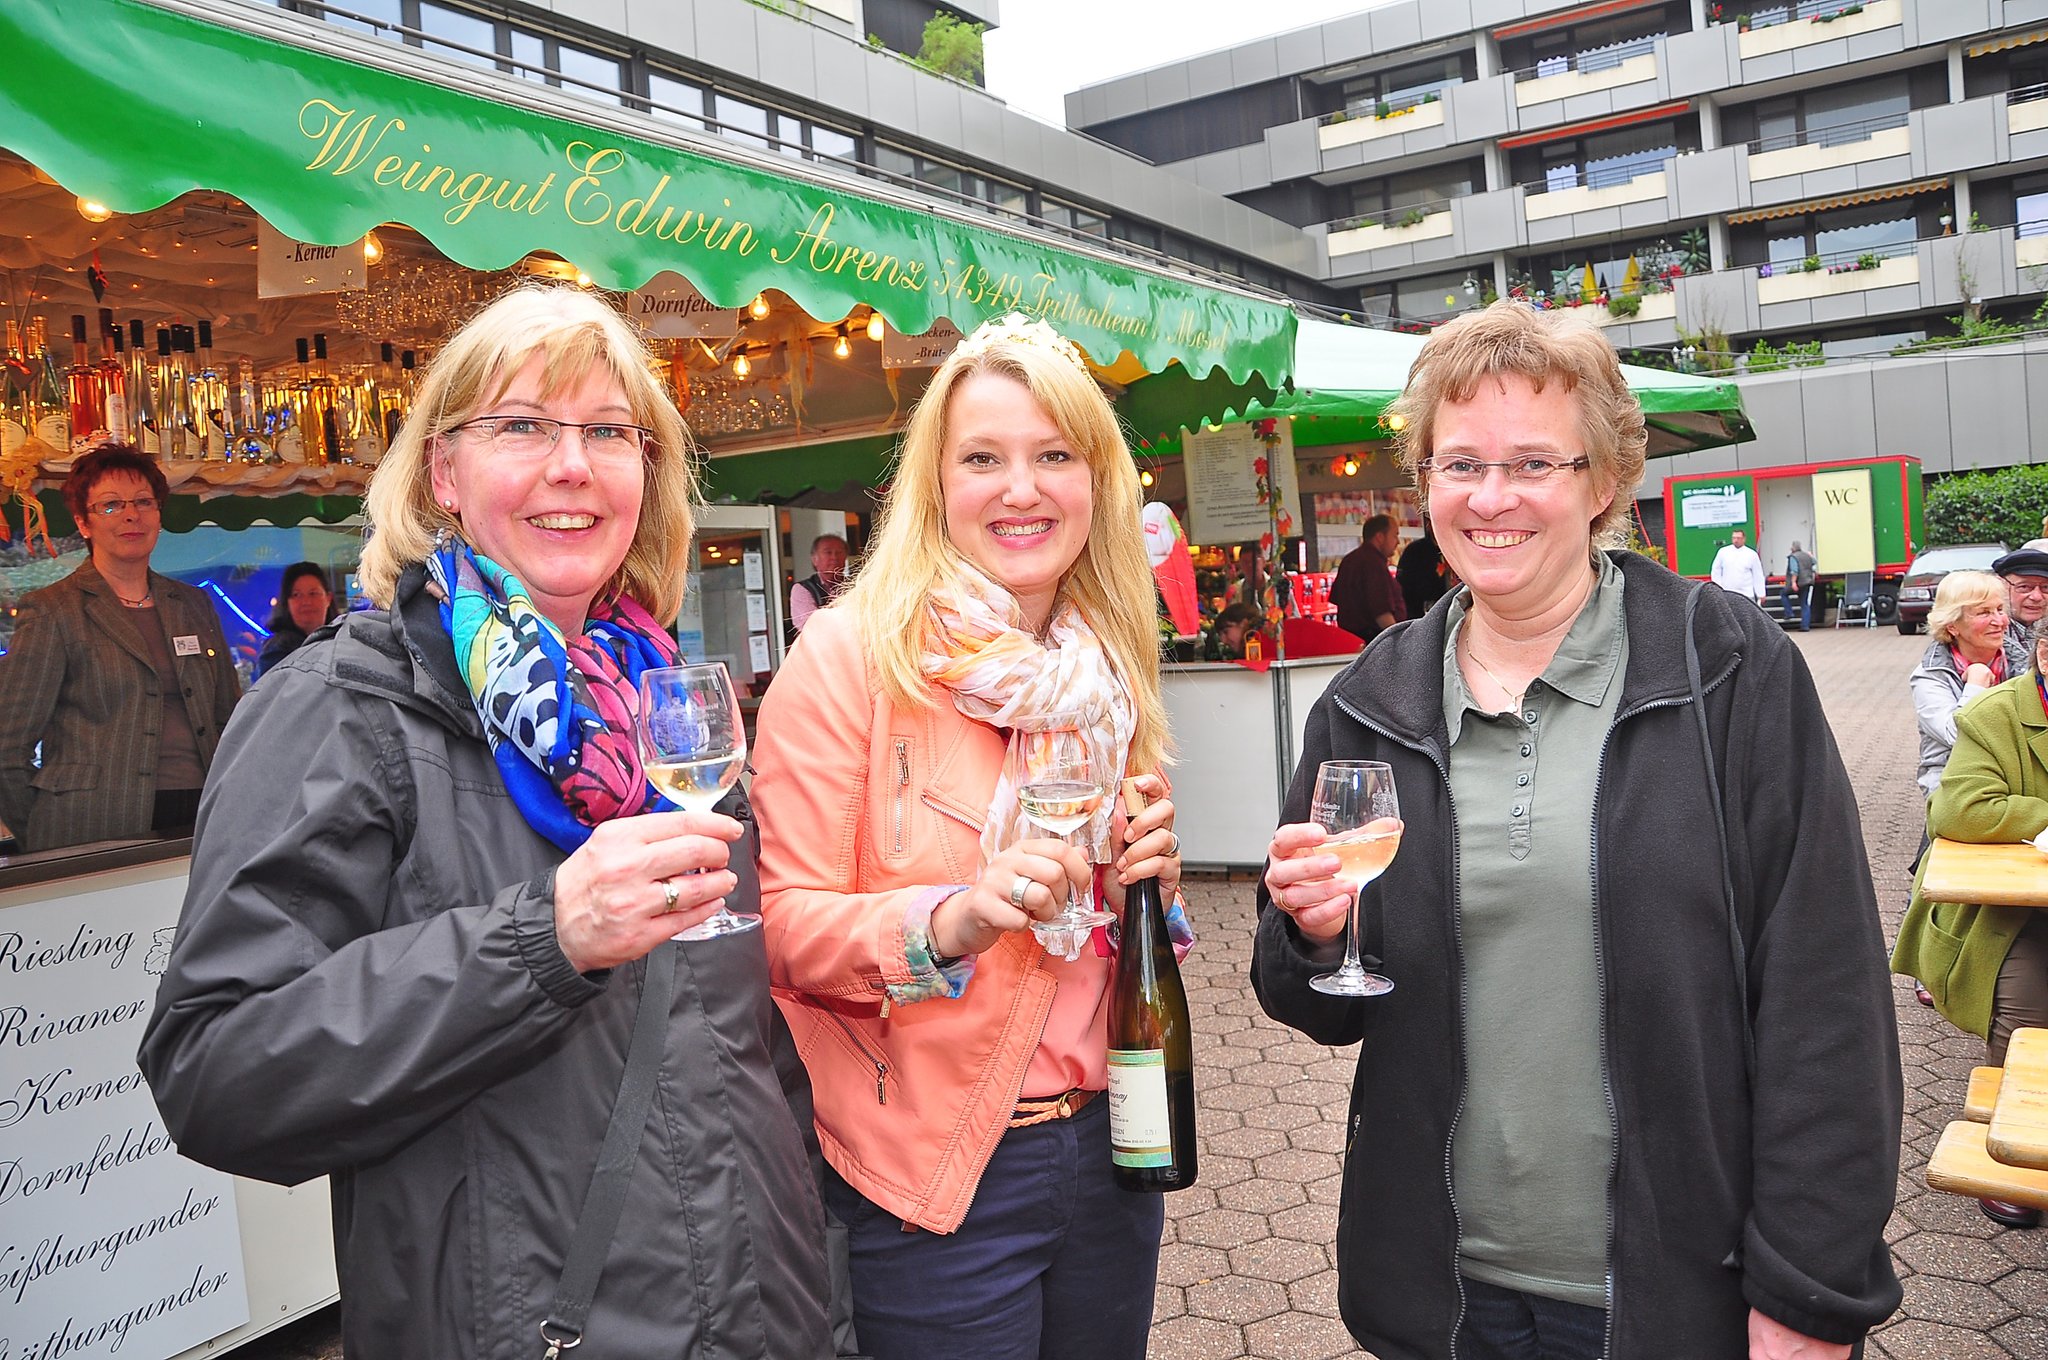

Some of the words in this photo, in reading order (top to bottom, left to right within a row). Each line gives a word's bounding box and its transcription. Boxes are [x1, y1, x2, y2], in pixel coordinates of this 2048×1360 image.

[299, 98, 557, 225] Weingut
[565, 141, 762, 256] Edwin
[770, 202, 928, 290] Arenz
[933, 258, 1023, 308] 54349
[1025, 272, 1149, 338] Trittenheim
[1167, 307, 1233, 351] Mosel
[294, 243, 339, 263] Kerner
[1824, 487, 1858, 506] WC
[0, 923, 136, 973] Riesling
[0, 1000, 146, 1047] Rivaner
[0, 1068, 147, 1129] Kerner
[0, 1189, 220, 1305] eißburgunder
[0, 1264, 229, 1360] ätburgunder
